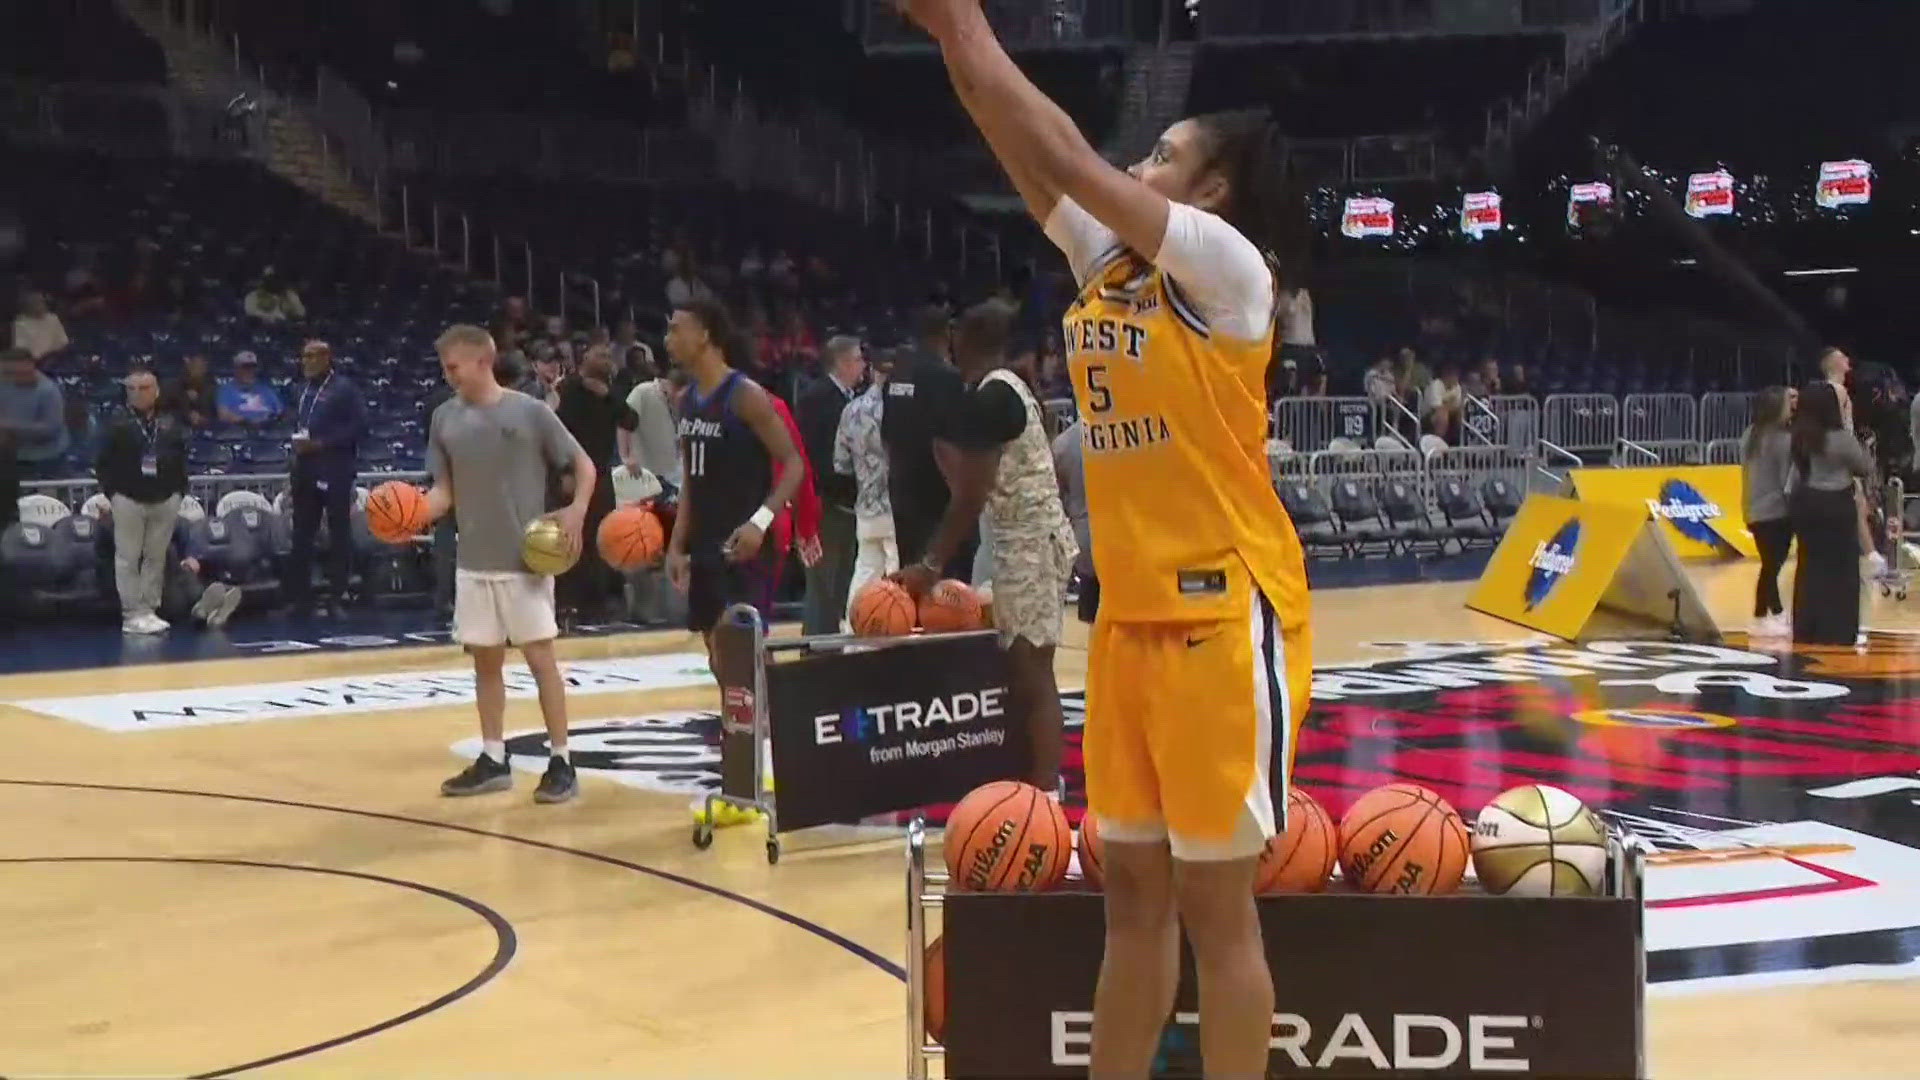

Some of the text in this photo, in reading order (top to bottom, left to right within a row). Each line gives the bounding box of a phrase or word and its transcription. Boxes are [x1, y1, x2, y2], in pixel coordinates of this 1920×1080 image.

[1064, 317, 1146, 358] WEST
[1086, 364, 1113, 414] 5
[690, 440, 705, 476] 11
[1645, 497, 1721, 522] Pedigree
[870, 727, 1006, 765] from Morgan Stanley
